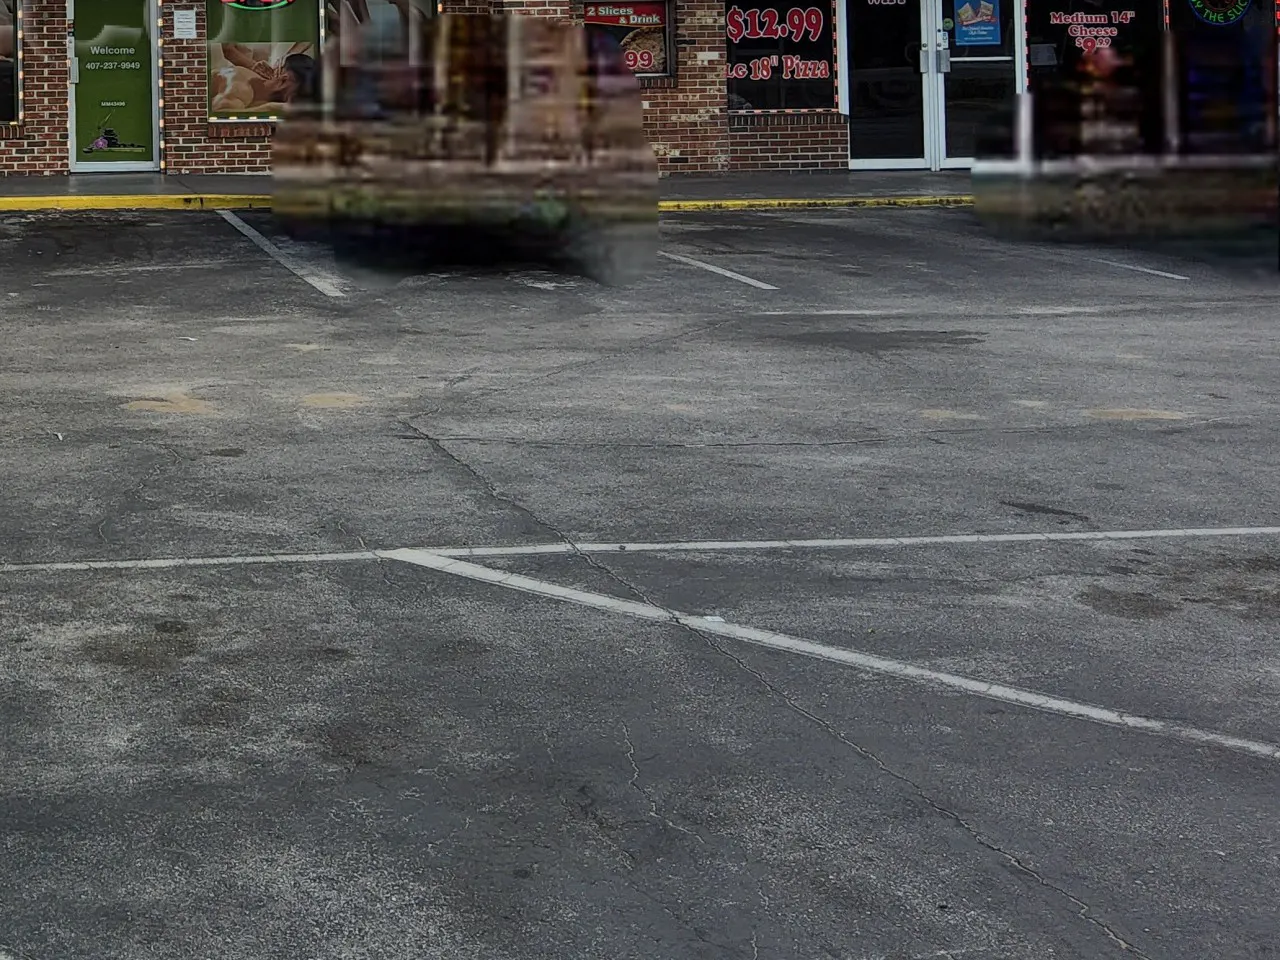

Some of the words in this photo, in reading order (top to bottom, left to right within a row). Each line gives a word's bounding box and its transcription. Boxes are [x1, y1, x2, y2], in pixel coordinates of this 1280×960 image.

[587, 6, 596, 16] 2
[598, 5, 634, 15] Slices
[1203, 8, 1225, 23] THE
[619, 16, 627, 24] &
[629, 14, 661, 24] Drink
[1050, 12, 1108, 24] Medium
[727, 5, 823, 44] $12.99
[1068, 25, 1118, 37] Cheese
[90, 46, 135, 55] Welcome
[85, 61, 141, 70] 407-237-9949
[782, 55, 830, 80] Pizza
